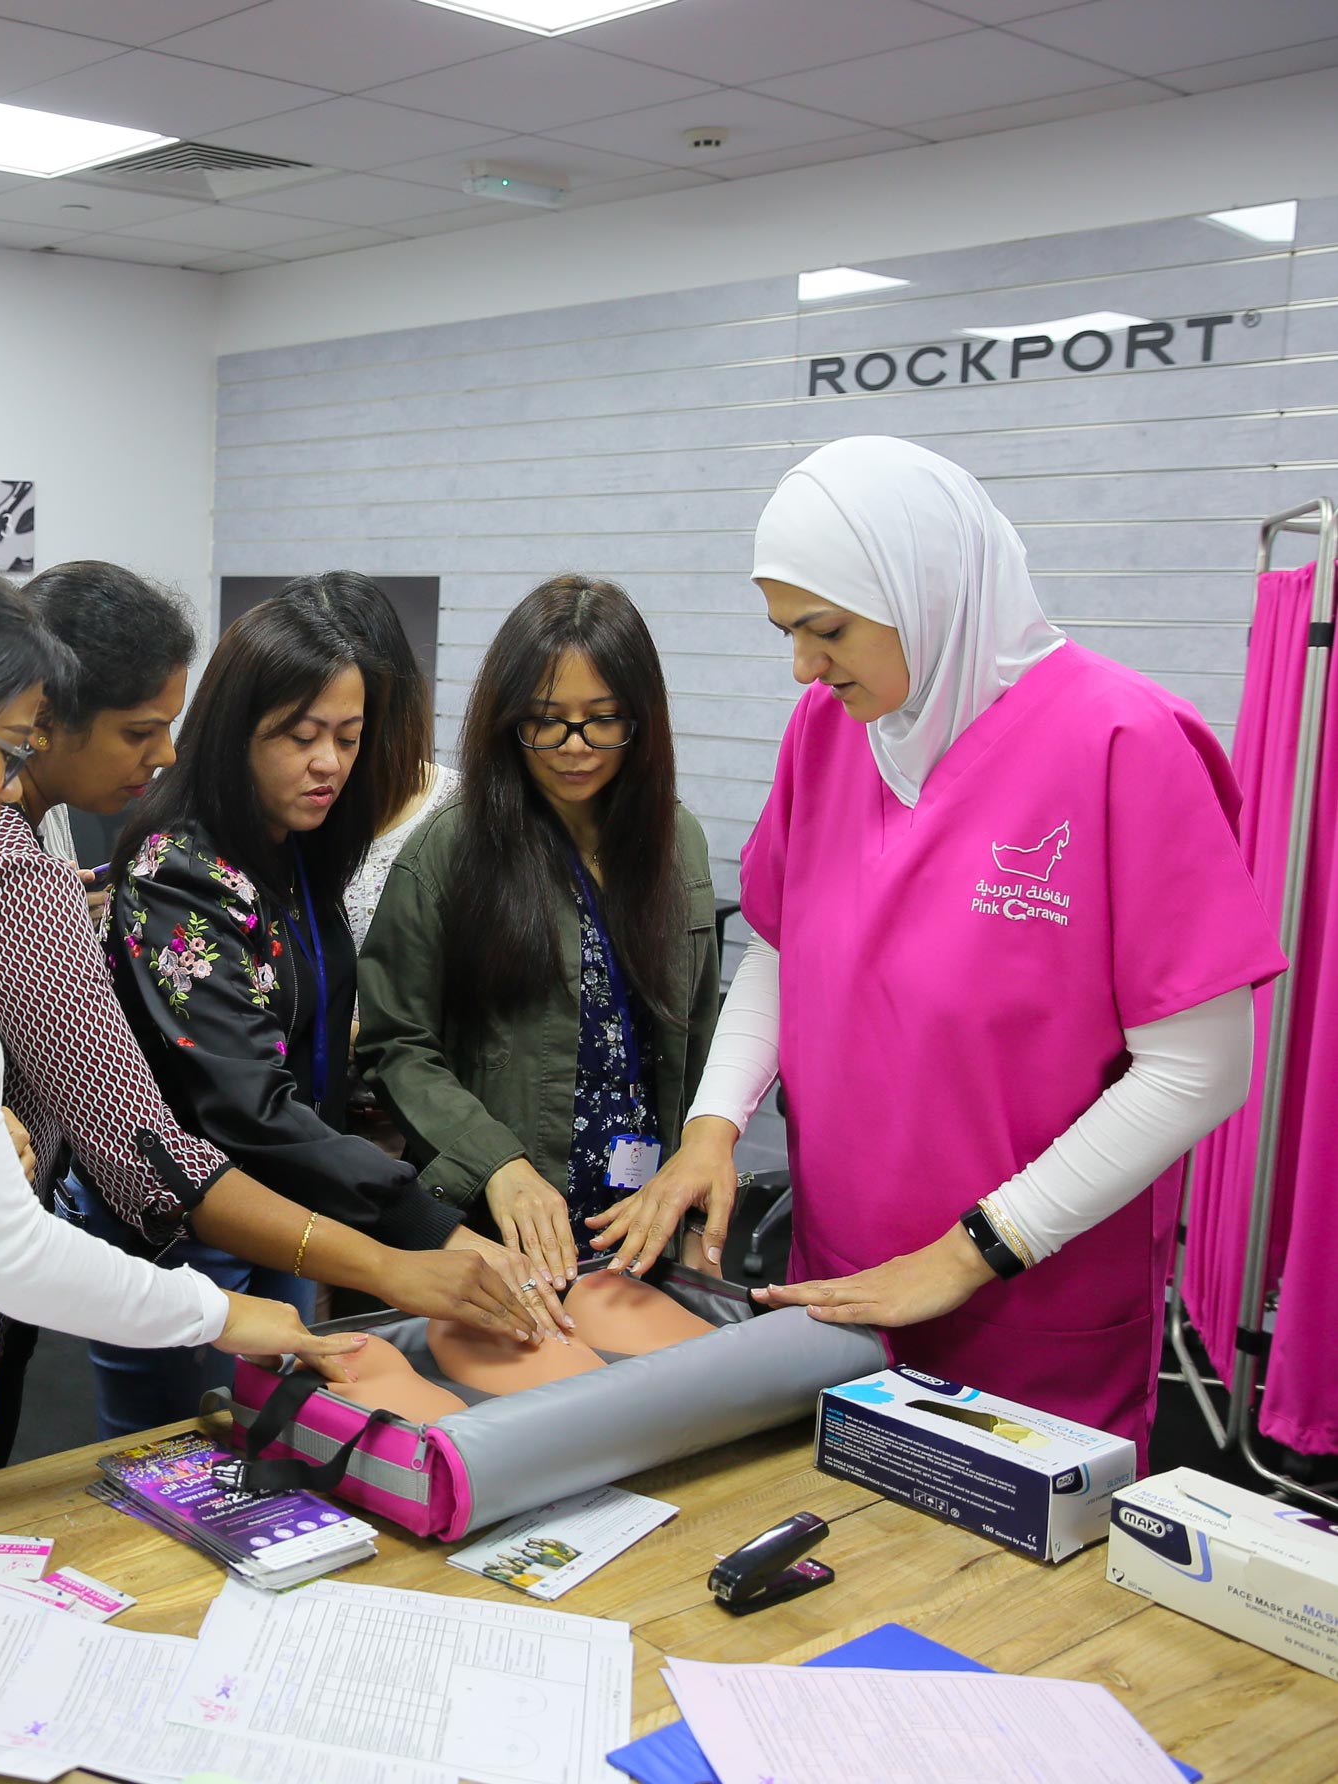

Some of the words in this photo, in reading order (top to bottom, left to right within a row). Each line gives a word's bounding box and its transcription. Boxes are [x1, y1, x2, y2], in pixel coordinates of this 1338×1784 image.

[808, 315, 1234, 397] ROCKPORT
[975, 879, 1022, 898] الوردية
[1026, 885, 1070, 909] القافلة
[971, 898, 1000, 915] Pink
[1003, 899, 1068, 926] Caravan
[1036, 1417, 1100, 1443] GLOVES
[981, 1522, 994, 1534] 100
[1227, 1584, 1253, 1602] FACE
[1255, 1596, 1284, 1616] MASK
[1286, 1608, 1338, 1637] EARLOOP
